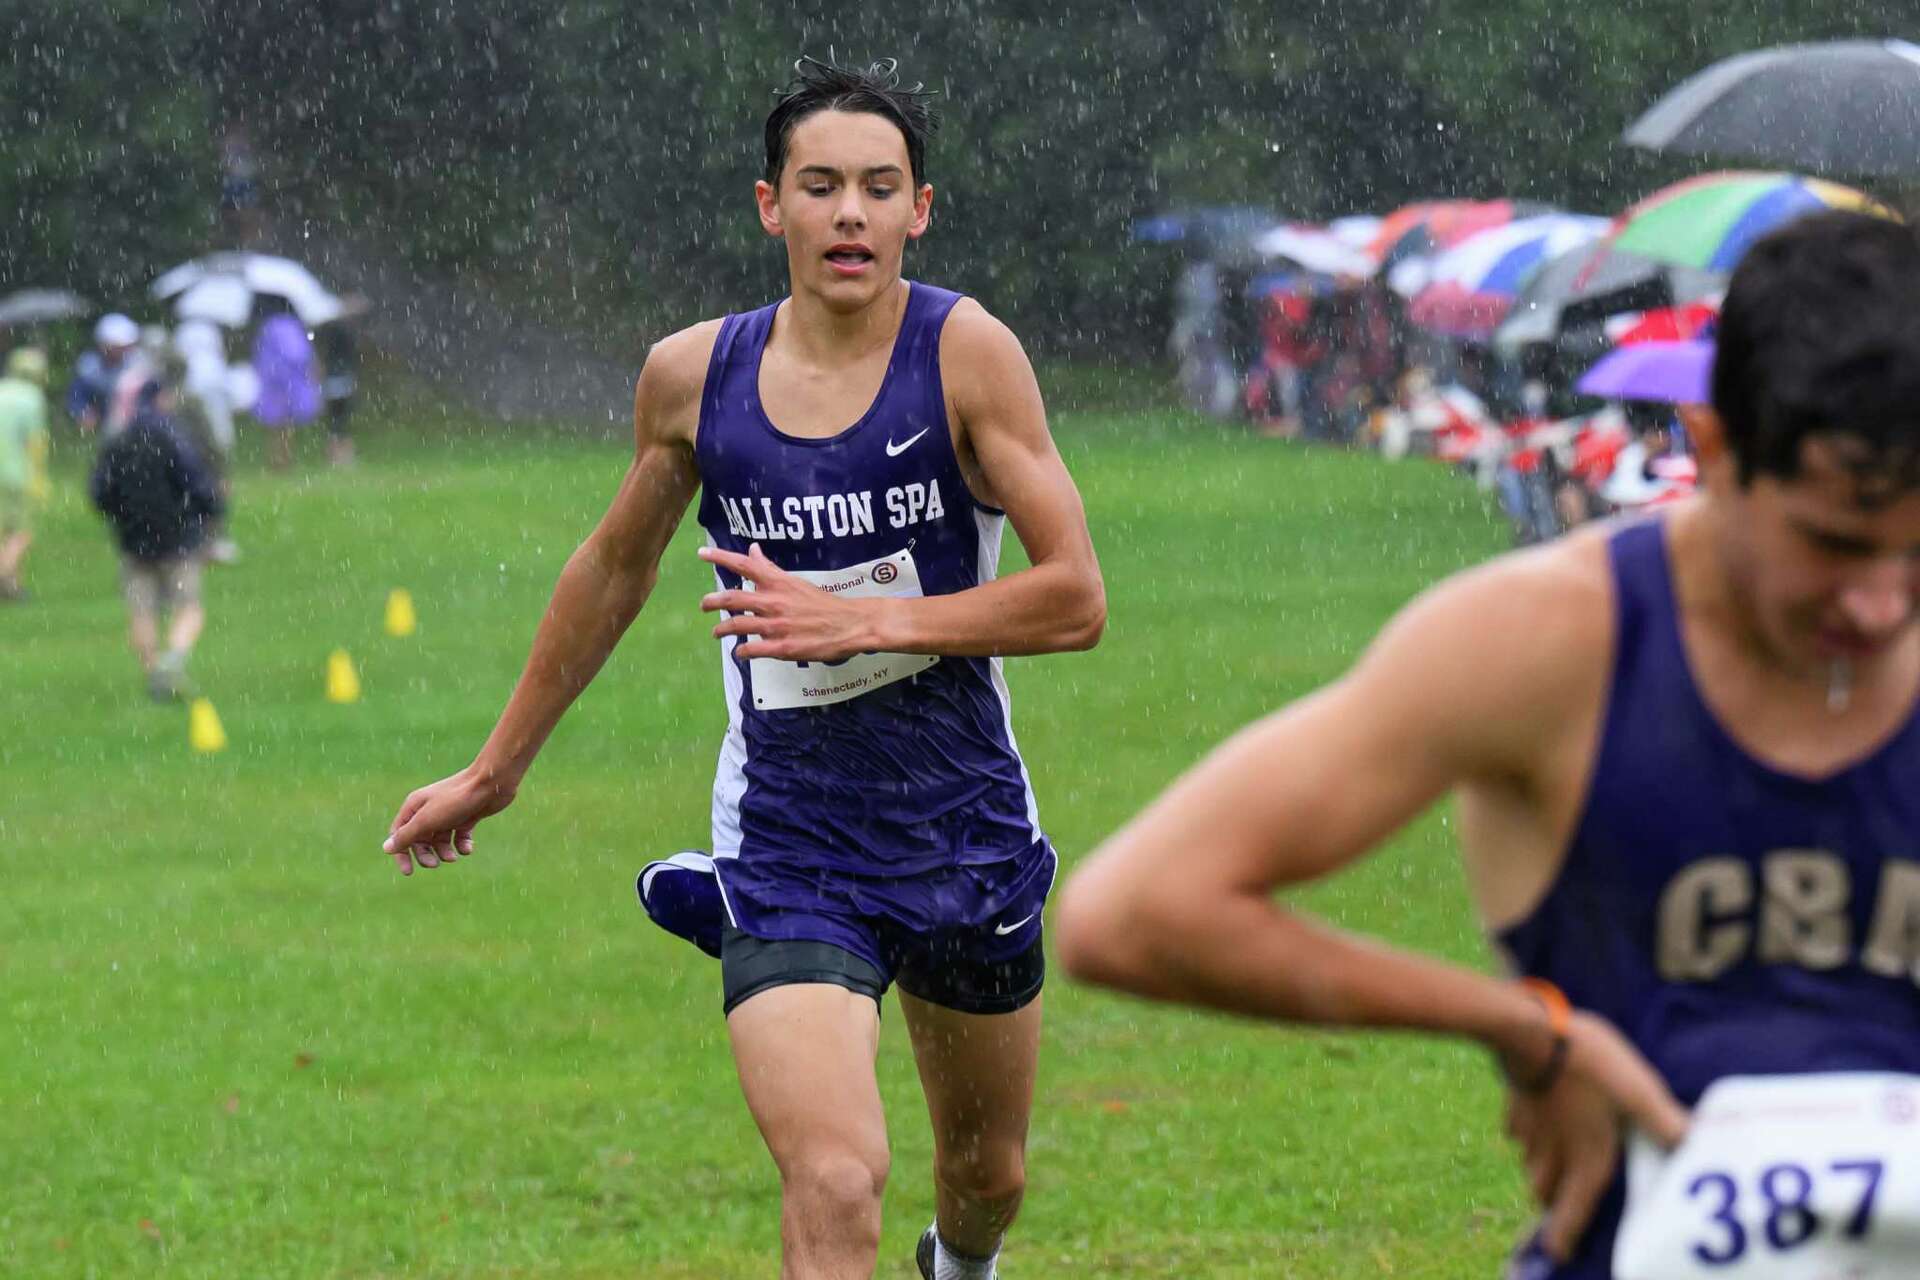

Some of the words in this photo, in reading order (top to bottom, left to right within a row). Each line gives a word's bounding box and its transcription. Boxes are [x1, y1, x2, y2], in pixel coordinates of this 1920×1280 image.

[885, 479, 944, 528] SPA
[802, 676, 872, 697] Schenectady,
[874, 667, 889, 681] NY
[1688, 1160, 1884, 1266] 387
